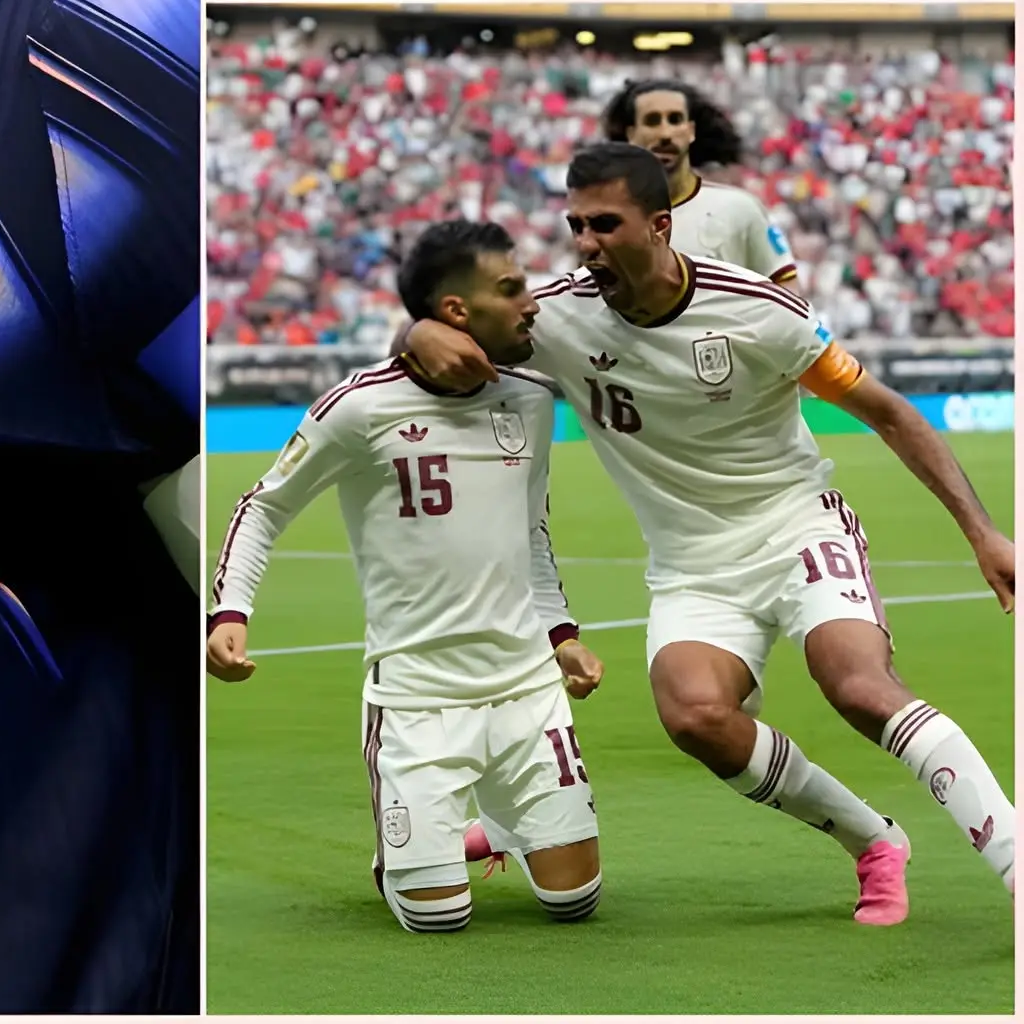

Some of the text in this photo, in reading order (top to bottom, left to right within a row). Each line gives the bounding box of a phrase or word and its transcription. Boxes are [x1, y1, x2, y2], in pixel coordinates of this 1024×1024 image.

[583, 376, 643, 434] 16
[392, 454, 453, 517] 15
[797, 541, 857, 584] 16
